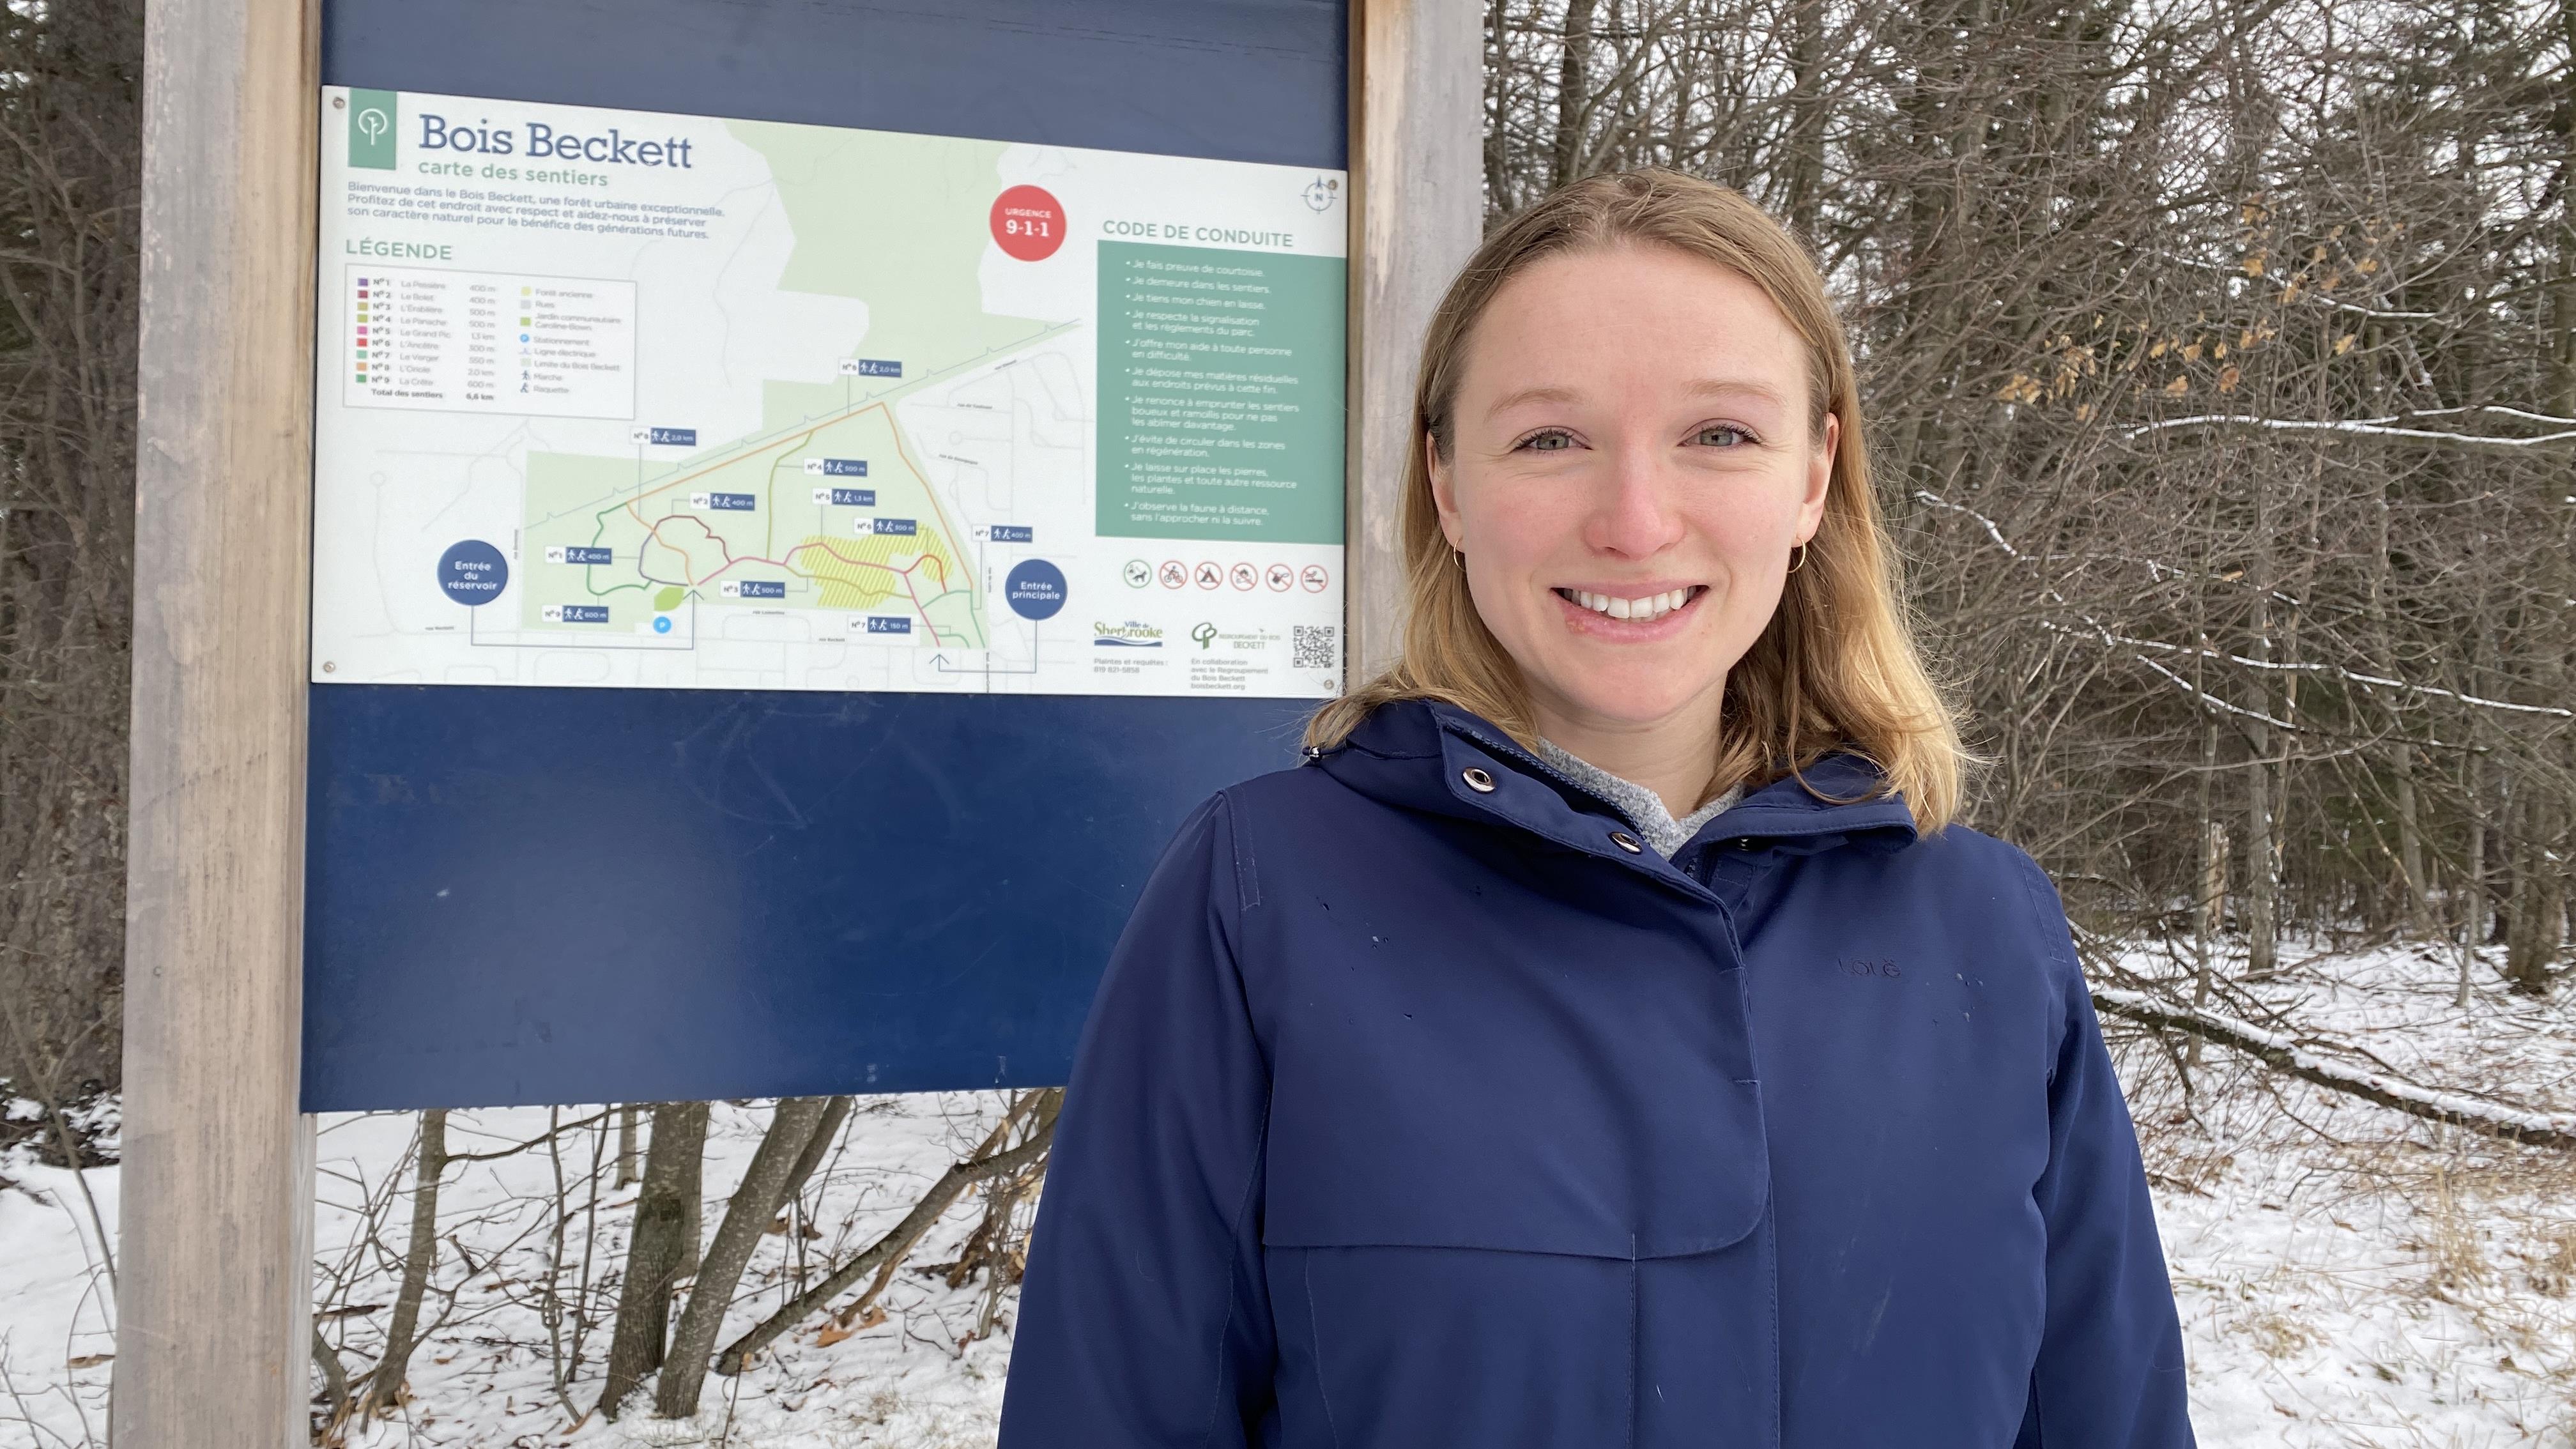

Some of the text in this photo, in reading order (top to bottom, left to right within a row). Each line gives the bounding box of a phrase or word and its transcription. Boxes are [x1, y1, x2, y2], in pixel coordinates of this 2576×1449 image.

[419, 115, 691, 168] Bois Beckett
[418, 160, 608, 187] carte des sentiers
[348, 181, 724, 220] Bienvenue dans le Bois Beckett, une forêt urbaine exceptionnelle.
[1314, 194, 1324, 203] N
[347, 194, 395, 206] Profitez
[398, 197, 414, 208] de
[417, 199, 436, 209] cet
[439, 200, 482, 212] endroit
[484, 205, 512, 214] avec
[515, 205, 559, 220] respect
[562, 208, 574, 218] et
[577, 209, 640, 222] aidez-nous
[652, 214, 706, 229] préserver
[1003, 208, 1053, 218] URGENCE
[346, 207, 709, 238] son caractère naturel pour le bénéfice des générations futures.
[1006, 220, 1048, 237] 9-1-1
[1103, 220, 1292, 247] CODE DE CONDUITE
[345, 238, 451, 260] LÉGENDE
[1133, 260, 1265, 277] Je fais preuve de courtoisie.
[1132, 277, 1271, 293] Je demeure dans les sentiers.
[1132, 293, 1144, 303] Je
[1146, 294, 1169, 304] tiens
[1195, 297, 1222, 307] chien
[1237, 299, 1267, 310] laisse.
[1132, 310, 1259, 328] Je respecte la signalisation
[1131, 321, 1255, 339] et les règlements du parc.
[1132, 339, 1163, 349] J'offre
[1189, 341, 1210, 351] aide
[1220, 343, 1246, 353] toute
[1247, 347, 1292, 358] personne
[1146, 350, 1192, 361] difficulté.
[1131, 367, 1144, 376] Je
[1145, 367, 1181, 380] dépose
[1205, 371, 1247, 381] matières
[1248, 372, 1298, 383] résiduelles
[1151, 379, 1192, 390] endroits
[1193, 381, 1226, 394] prévus
[1236, 383, 1261, 393] cette
[1262, 384, 1278, 394] fin.
[1131, 434, 1285, 450] J'évite de circuler dans les zones
[1146, 446, 1211, 459] régénération.
[1131, 462, 1143, 471] Je
[1145, 463, 1171, 472] laisse
[1190, 464, 1216, 477] place
[1218, 466, 1232, 475] les
[1233, 466, 1269, 479] pierres,
[1131, 473, 1297, 489] les plantes et toute autre ressource
[1131, 484, 1176, 494] naturelle.
[1131, 502, 1177, 512] J'observe
[1179, 503, 1188, 512] la
[1190, 503, 1217, 513] faune
[1227, 505, 1271, 516] distance,
[1154, 514, 1209, 526] l'approcher
[1211, 516, 1220, 524] ni
[1222, 516, 1230, 525] la
[1232, 516, 1263, 525] suivre.
[454, 561, 491, 571] Entrée
[464, 572, 479, 580] du
[447, 581, 497, 590] réservoir
[1020, 581, 1052, 590] Entrée
[1012, 591, 1060, 599] principale
